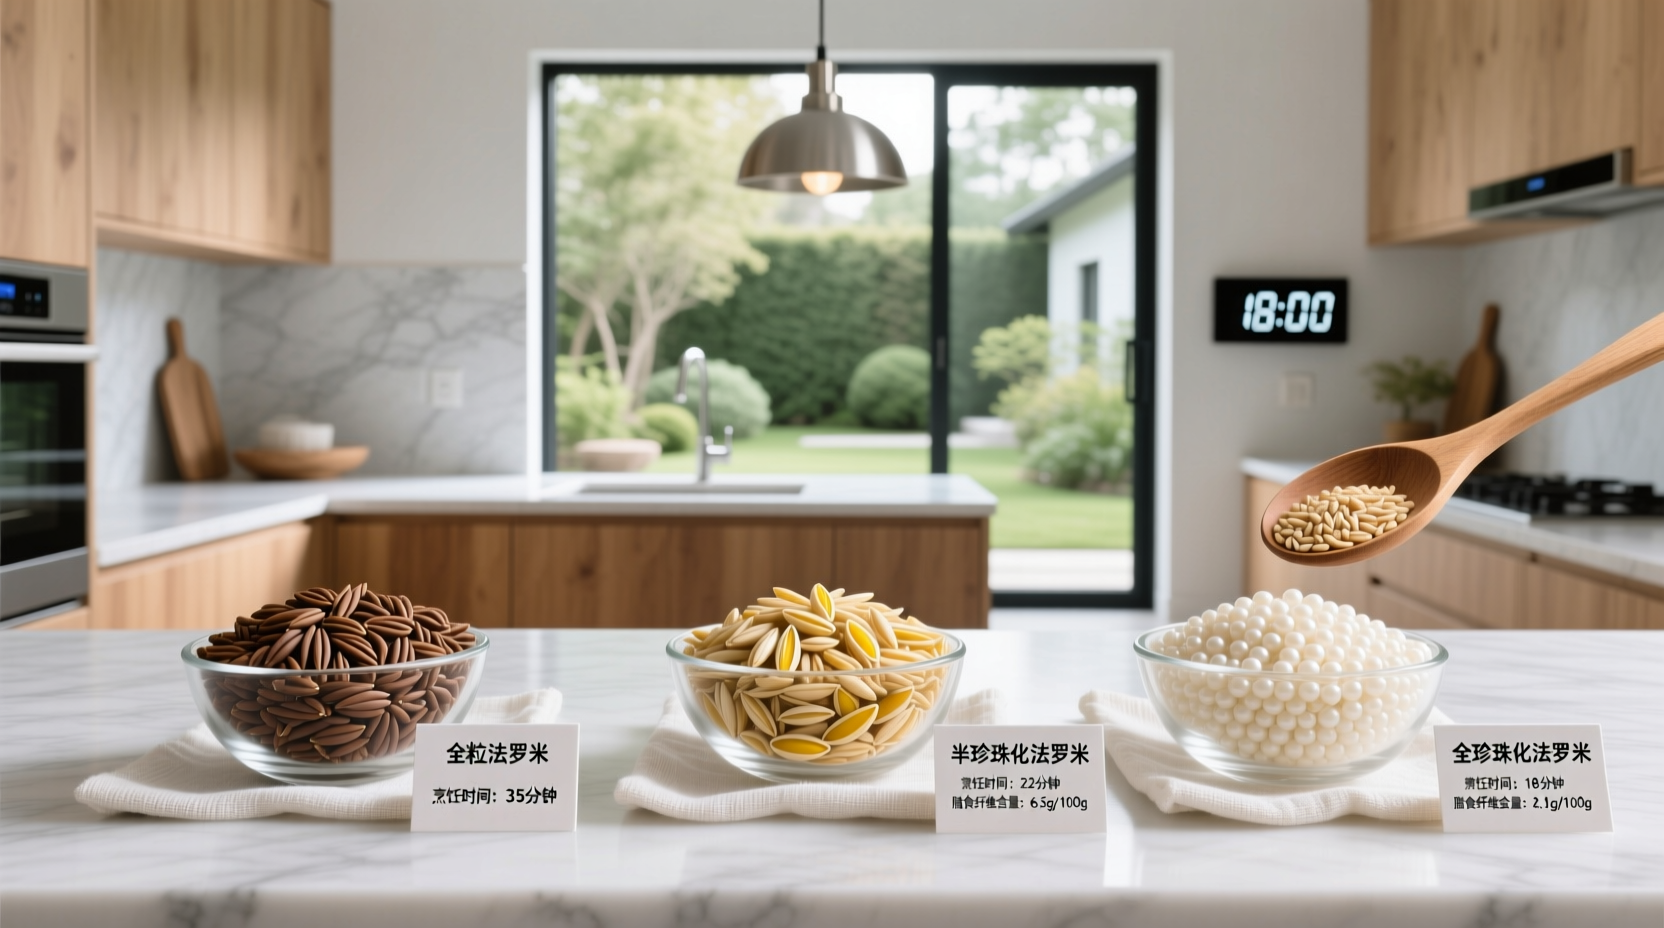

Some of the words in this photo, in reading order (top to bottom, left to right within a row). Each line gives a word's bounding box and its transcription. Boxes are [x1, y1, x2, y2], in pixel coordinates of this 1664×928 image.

[1242, 290, 1336, 333] 18:00
[446, 740, 549, 765] 全粒法罗米
[950, 742, 1090, 766] 半珍珠化法罗米
[1451, 741, 1592, 765] 全珍珠化法罗米
